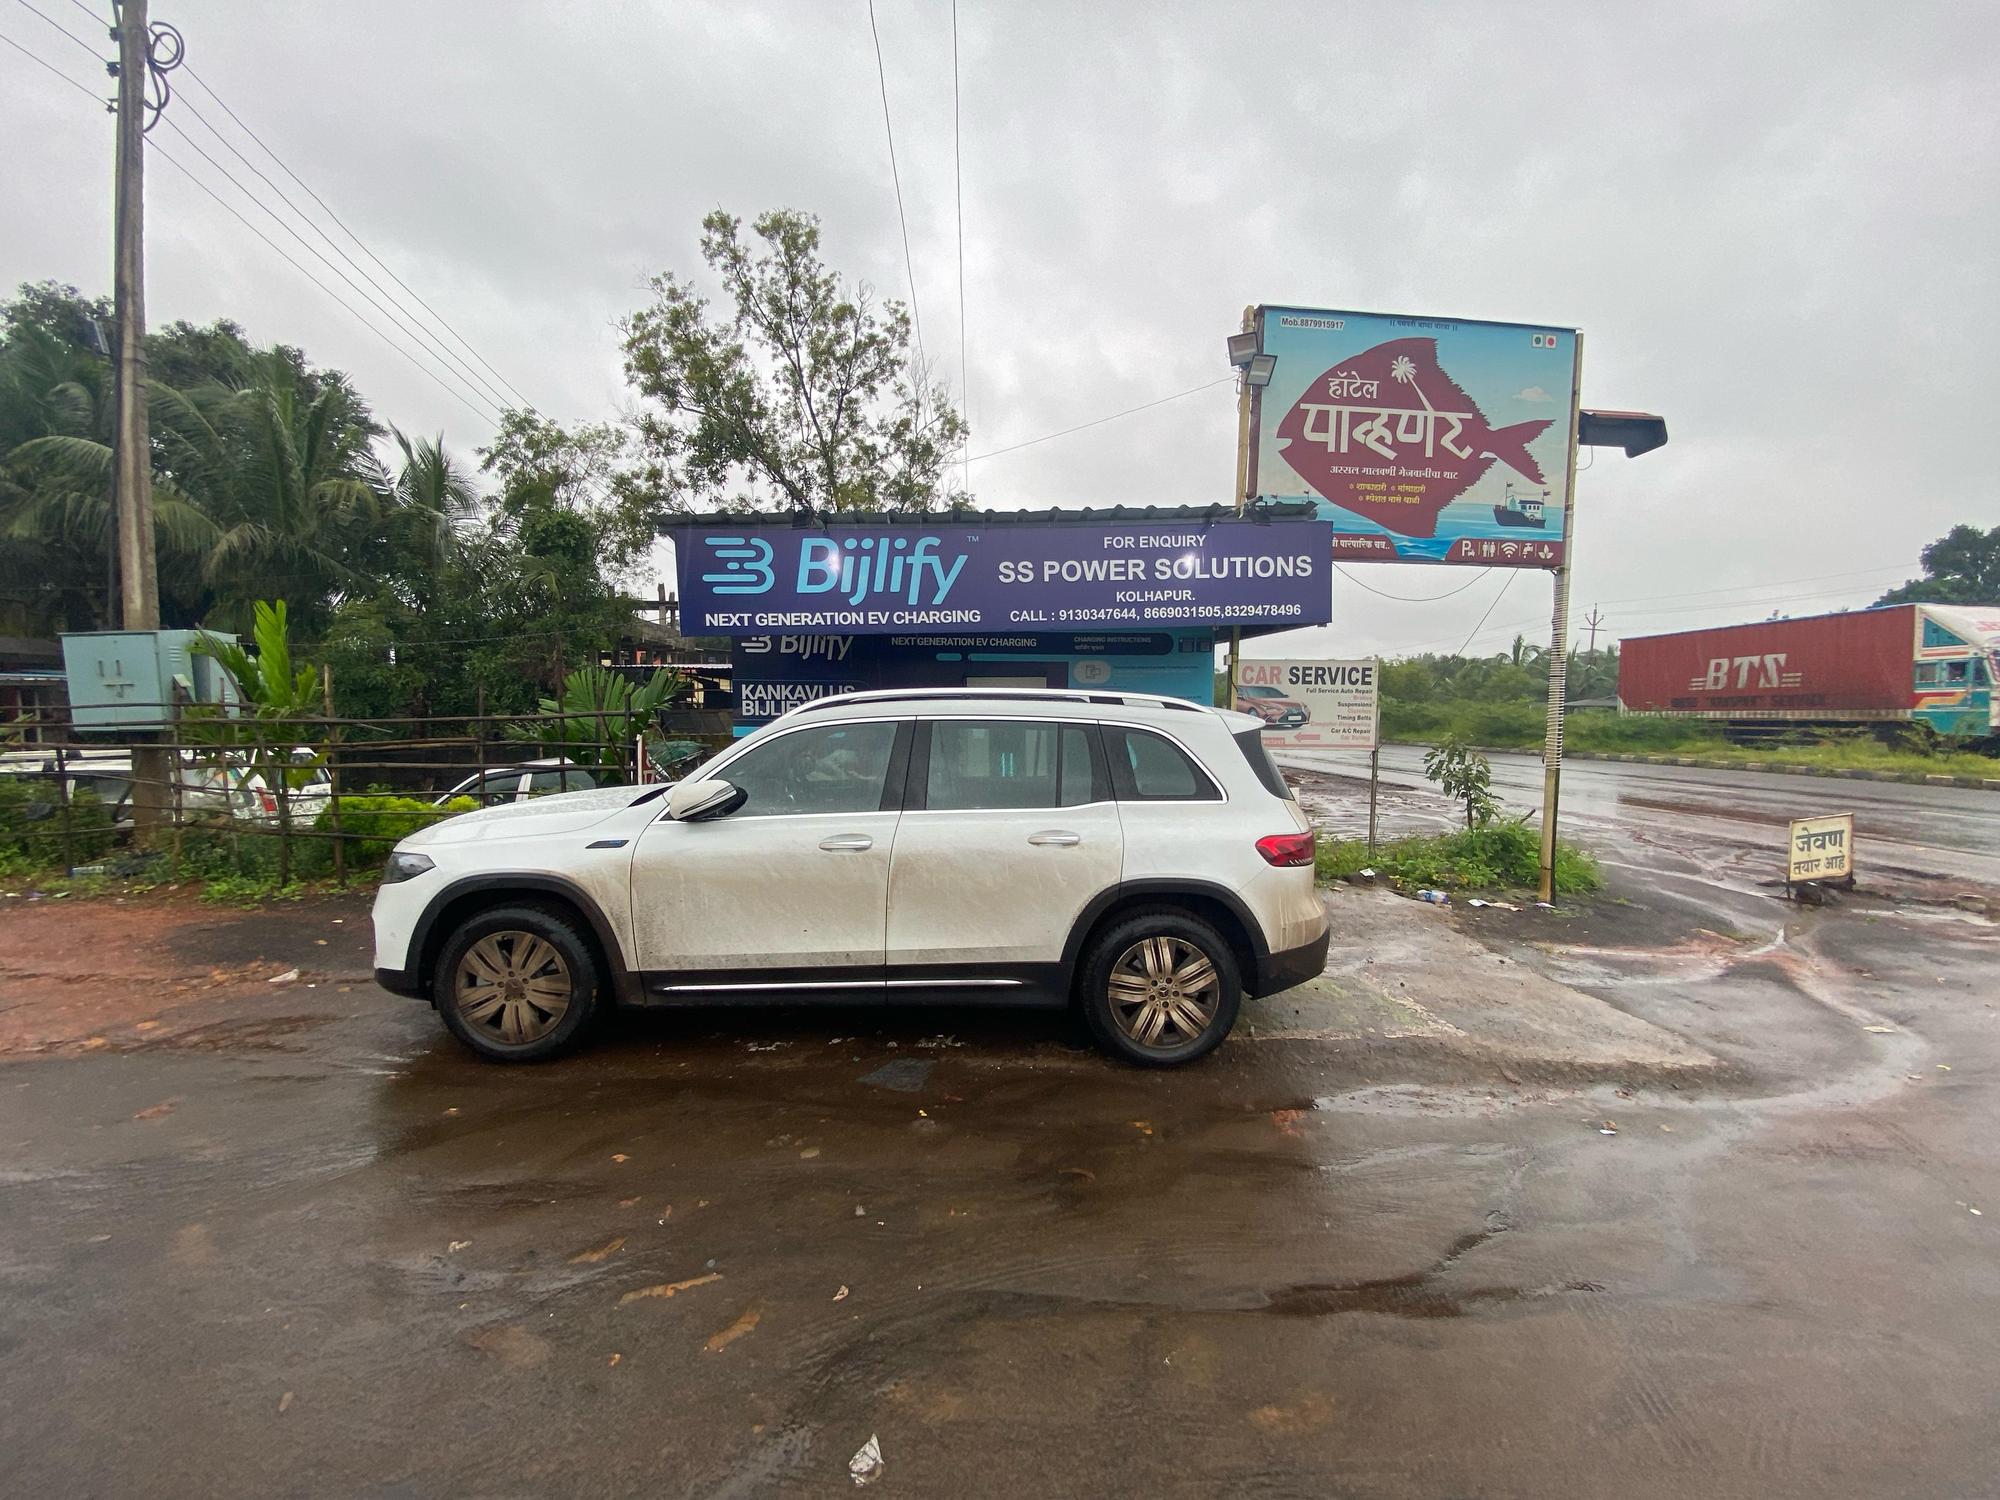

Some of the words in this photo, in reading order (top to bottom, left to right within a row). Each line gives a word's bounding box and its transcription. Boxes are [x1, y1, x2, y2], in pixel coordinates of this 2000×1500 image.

[1281, 317, 1344, 330] Mob.8879915917
[1328, 371, 1380, 399] हॉटेल
[1330, 466, 1359, 475] अस्सल
[1361, 466, 1396, 477] मालवणी
[1443, 471, 1459, 479] थाट
[1103, 535, 1136, 549] FOR
[1138, 534, 1207, 549] ENQUIRY
[796, 536, 969, 607] Bijlify
[998, 561, 1034, 584] SS
[1043, 558, 1147, 583] POWER
[1154, 555, 1313, 581] SOLUTIONS
[1115, 589, 1196, 603] KOLHAPUR.
[705, 613, 752, 627] NEXT
[755, 611, 864, 627] GENERATION
[868, 611, 890, 625] EV
[893, 609, 981, 625] CHARGING
[1010, 609, 1048, 622] CALL
[1059, 607, 1140, 621] 9130347644,
[891, 637, 916, 646] NEXT
[917, 637, 975, 647] GENERATION
[976, 637, 988, 647] EV
[989, 637, 1037, 647] CHARGING
[1241, 665, 1282, 685] CAR
[1288, 666, 1373, 686] SERVICE
[1795, 827, 1845, 852] जेवण
[1793, 858, 1821, 875] तयार
[1824, 850, 1846, 871] आहे
